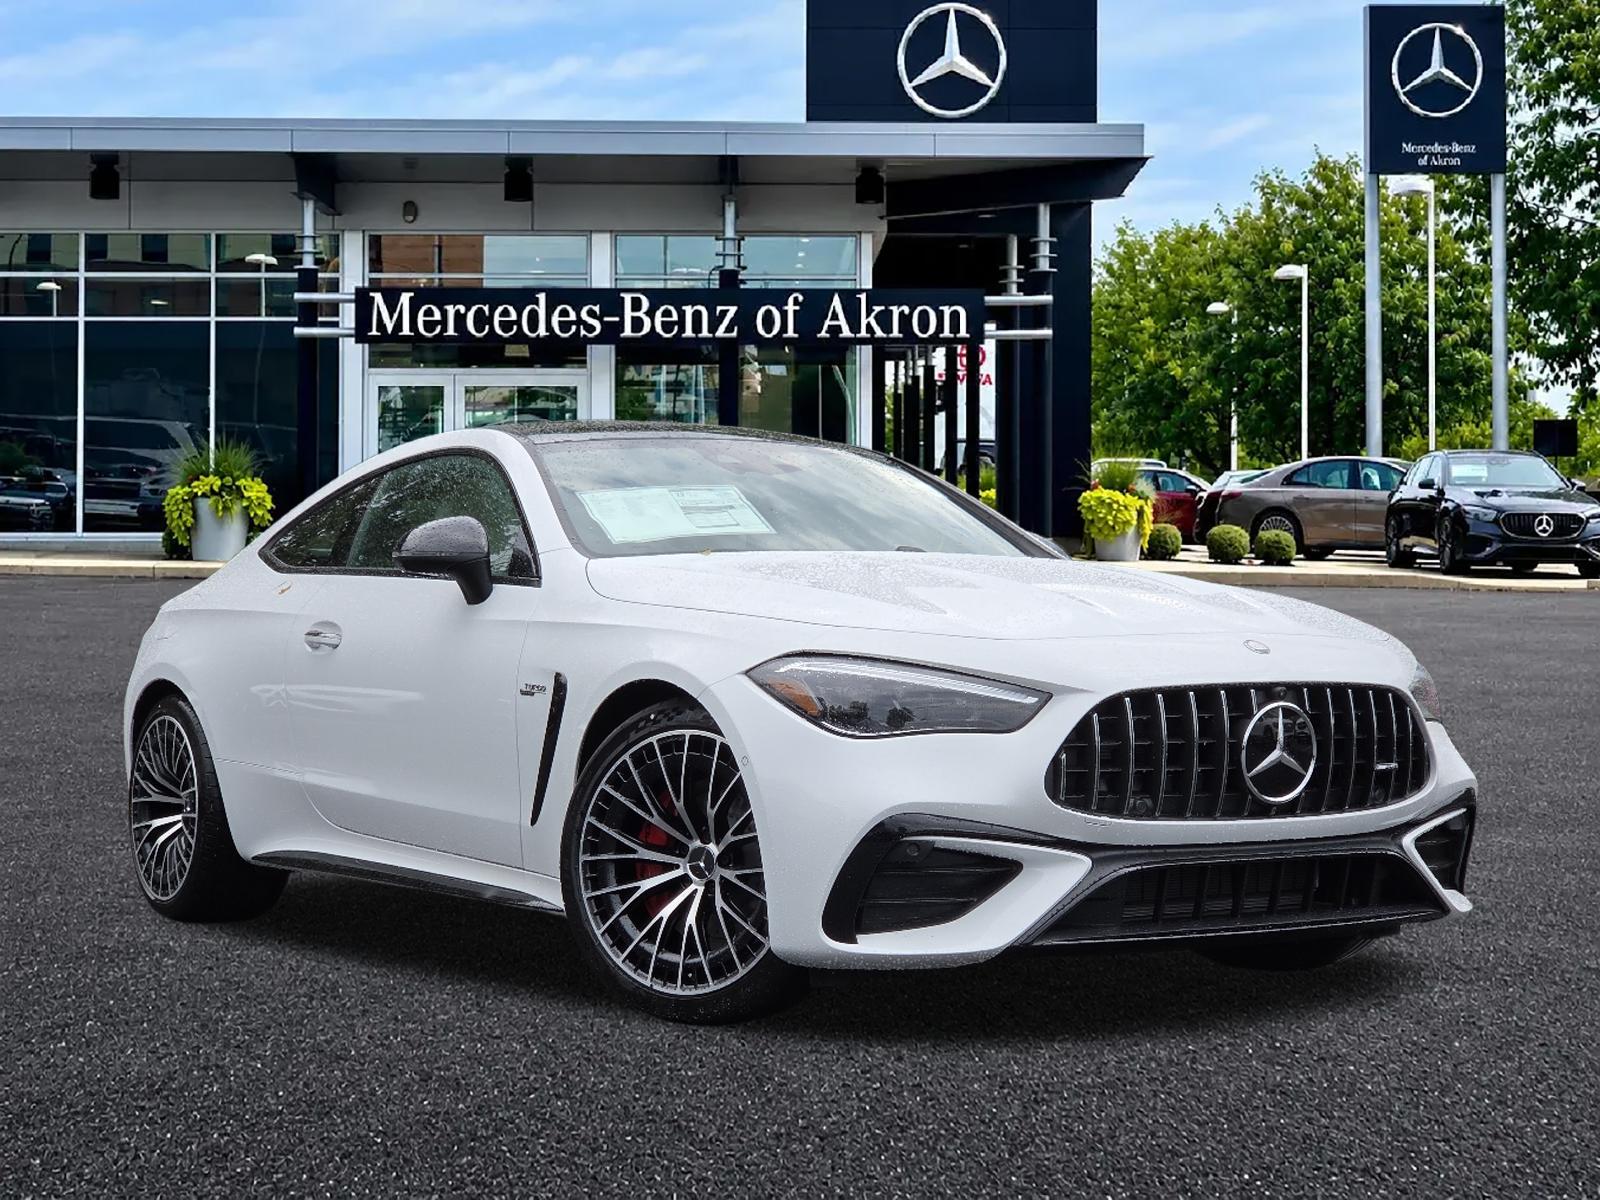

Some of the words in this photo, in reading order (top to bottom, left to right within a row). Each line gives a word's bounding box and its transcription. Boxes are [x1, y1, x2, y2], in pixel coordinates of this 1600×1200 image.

[1401, 141, 1477, 154] Mercedes-Benz
[1417, 154, 1428, 166] of
[1430, 154, 1461, 166] Akron
[367, 291, 738, 339] Mercedes-Benz
[755, 292, 804, 339] of
[816, 293, 971, 339] Akron
